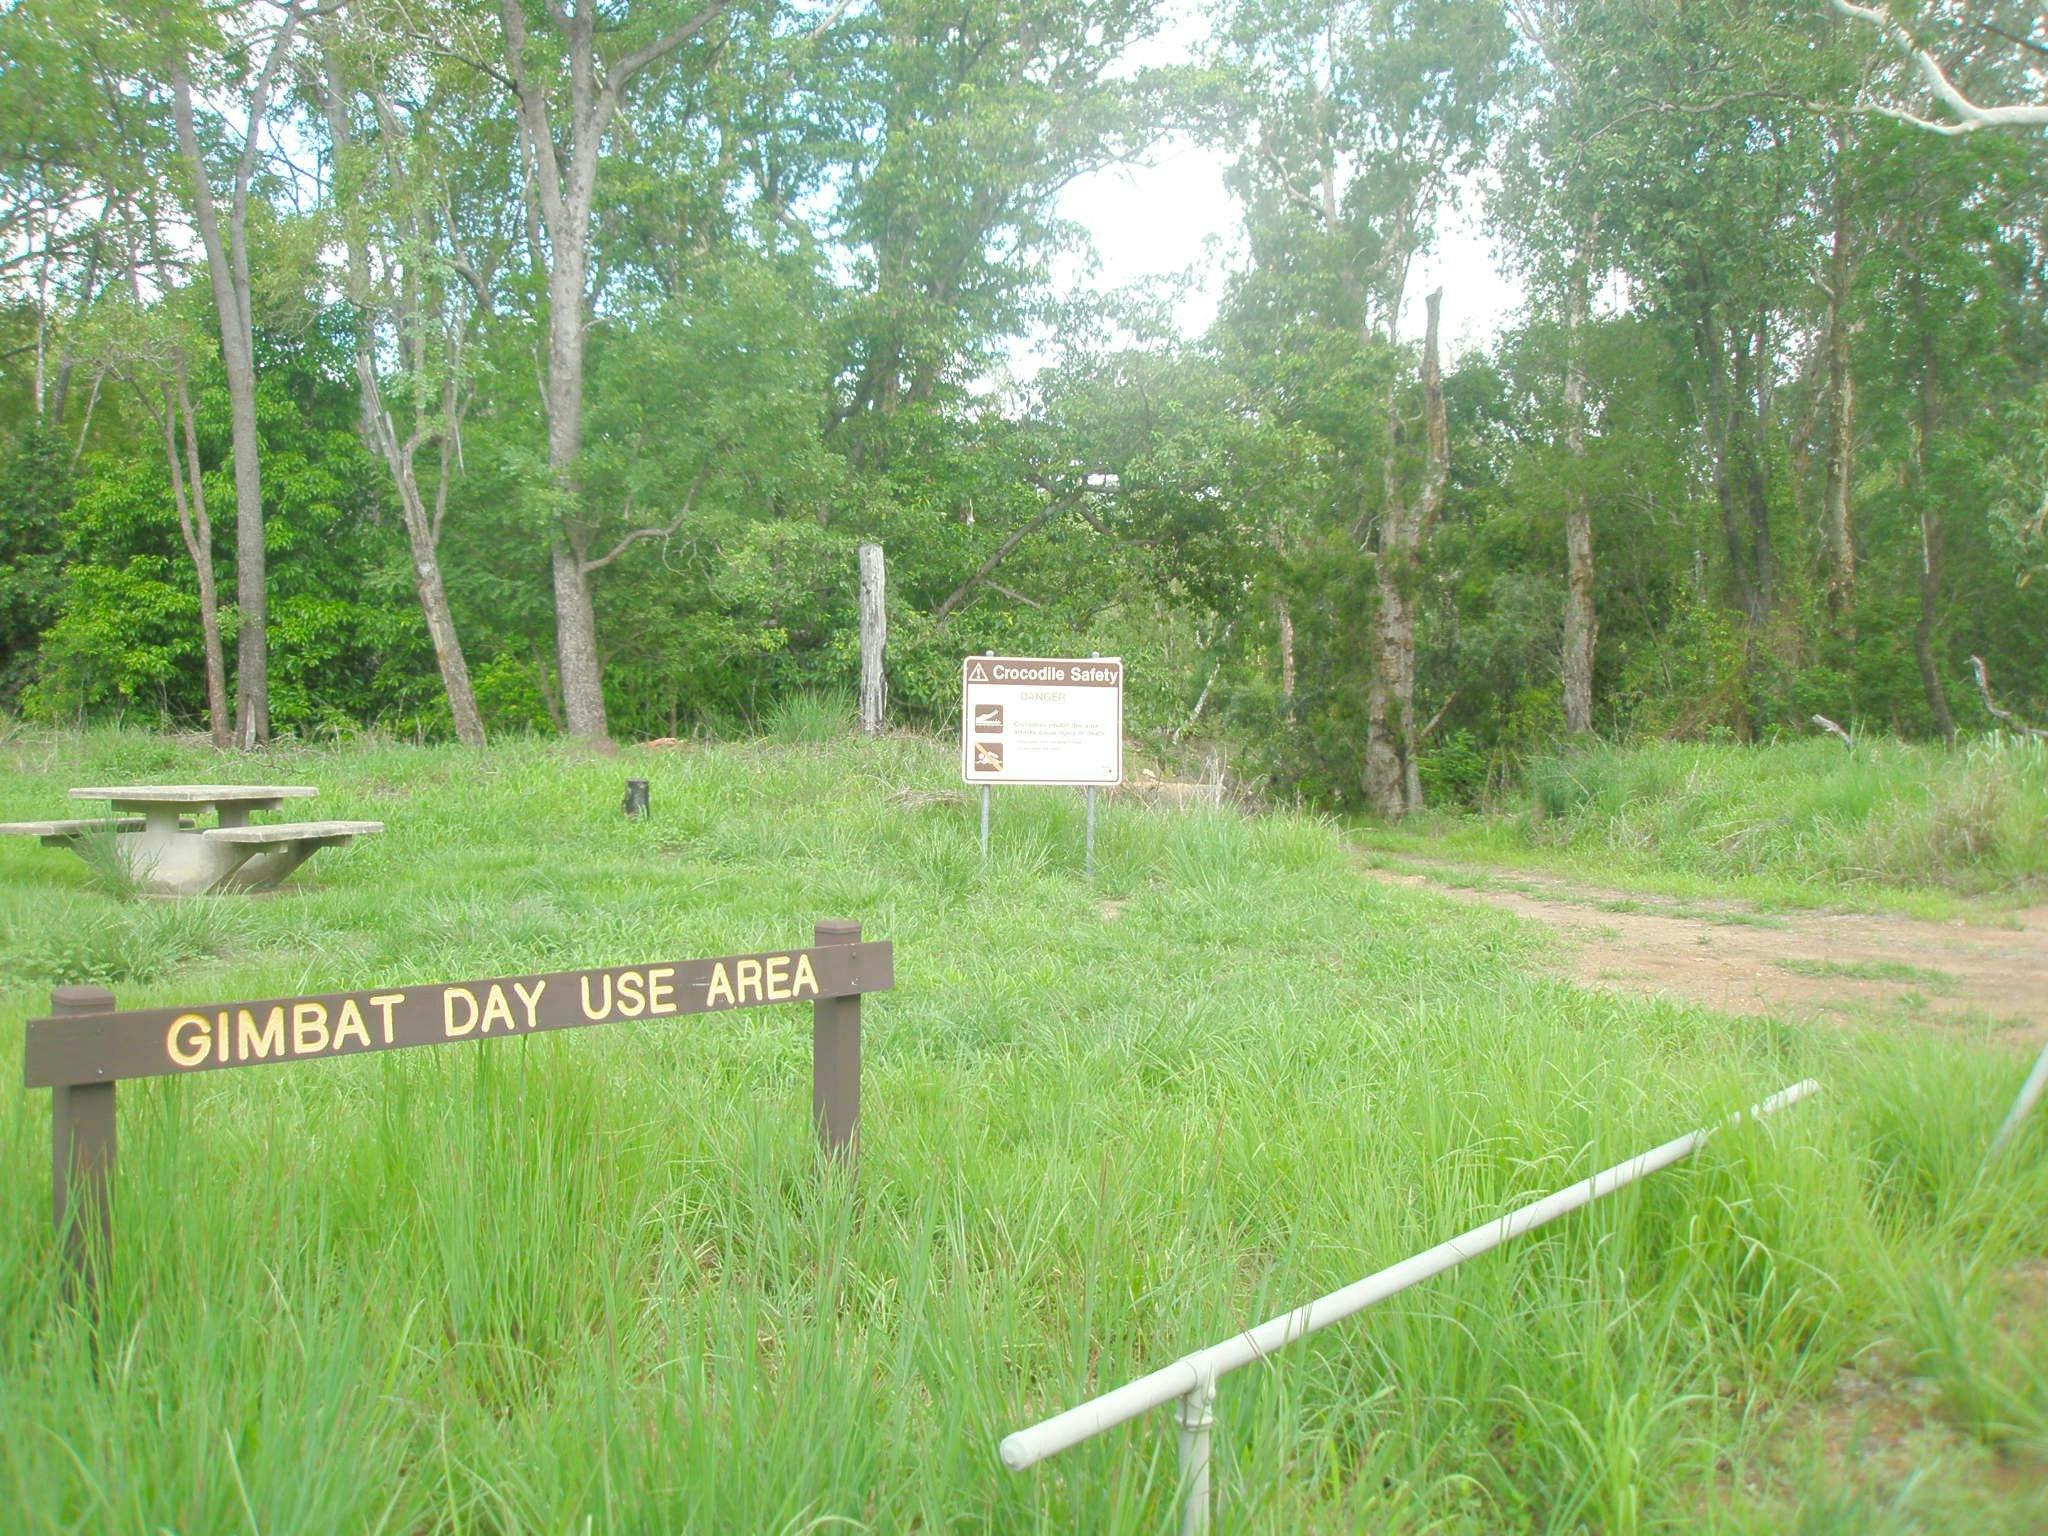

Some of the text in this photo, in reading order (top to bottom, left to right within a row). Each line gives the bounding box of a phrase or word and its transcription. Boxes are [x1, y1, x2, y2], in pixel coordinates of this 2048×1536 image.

[993, 665, 1118, 684] Crocodile Safety
[1020, 691, 1067, 702] DANGER
[166, 954, 819, 1066] GIMBAT DAY USE AREA
